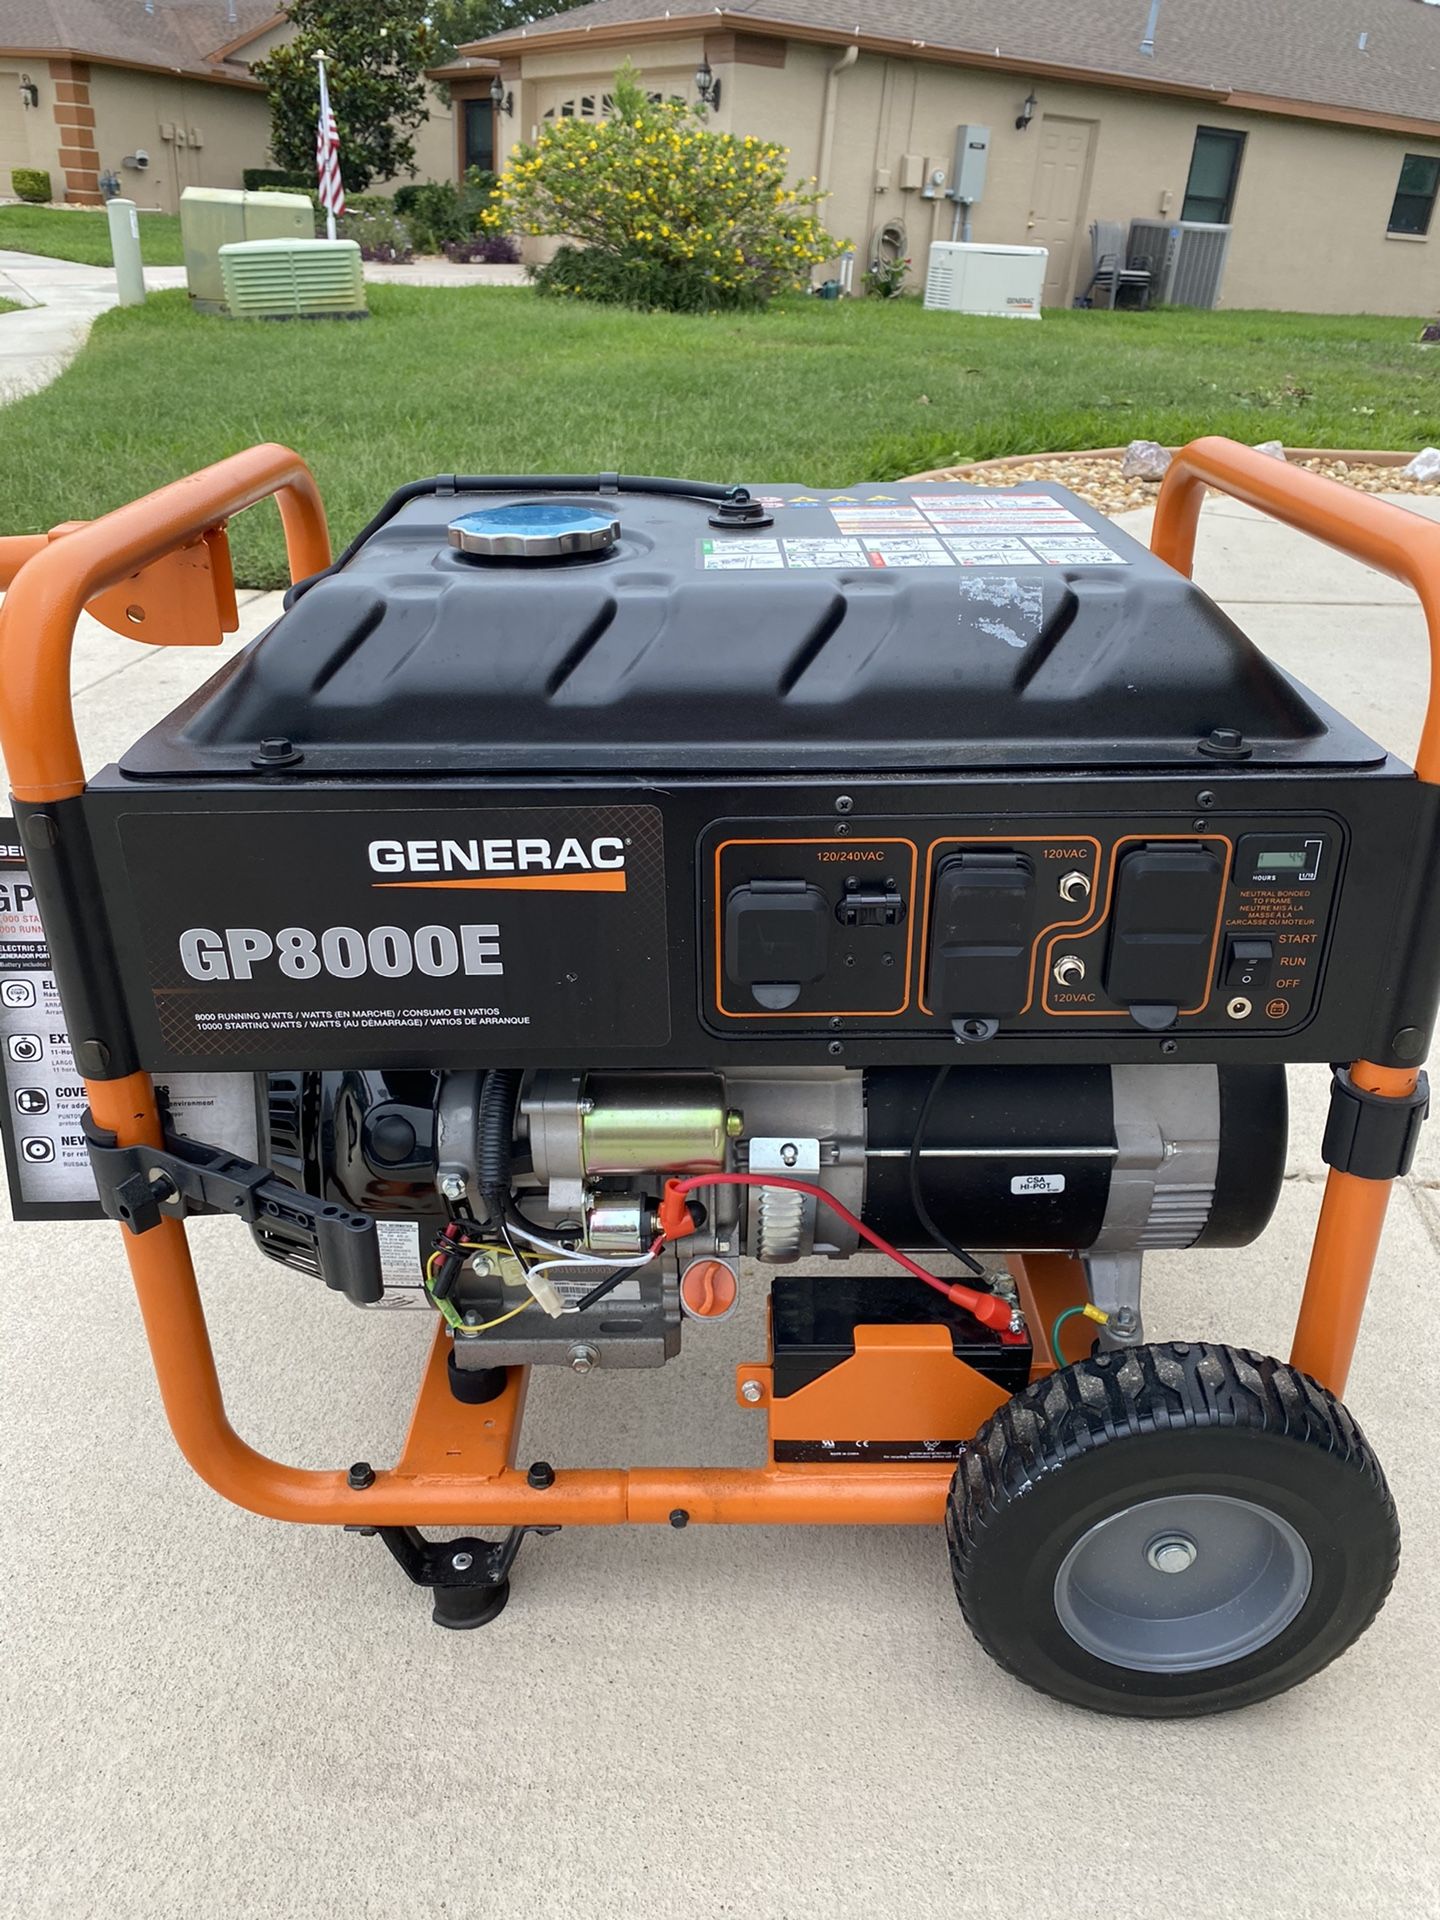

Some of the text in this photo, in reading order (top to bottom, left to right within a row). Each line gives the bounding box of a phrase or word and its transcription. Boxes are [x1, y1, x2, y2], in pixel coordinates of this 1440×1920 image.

[368, 837, 626, 872] GENERAC
[817, 851, 885, 861] 120/240VAC
[1043, 849, 1088, 859] 120VAC
[1279, 934, 1317, 944] START
[37, 944, 48, 952] ST
[179, 924, 504, 981] GP8000E
[1280, 957, 1306, 966] RUN
[1276, 979, 1300, 988] OFF
[1054, 993, 1096, 1002] 120VAC
[195, 1013, 216, 1021] 8000
[218, 1012, 261, 1020] RUNNING
[334, 1010, 350, 1019] (EN
[352, 1009, 395, 1018] MARCHE)
[402, 1009, 451, 1017] CONSUMO
[468, 1008, 500, 1016] VATIOS
[271, 1021, 302, 1029] WATTS
[310, 1020, 341, 1028] WATTS
[343, 1020, 359, 1028] (AU
[361, 1018, 423, 1027] DÉMARRAGE)
[430, 1018, 462, 1026] VATIOS
[479, 1017, 531, 1025] ARRANQUE
